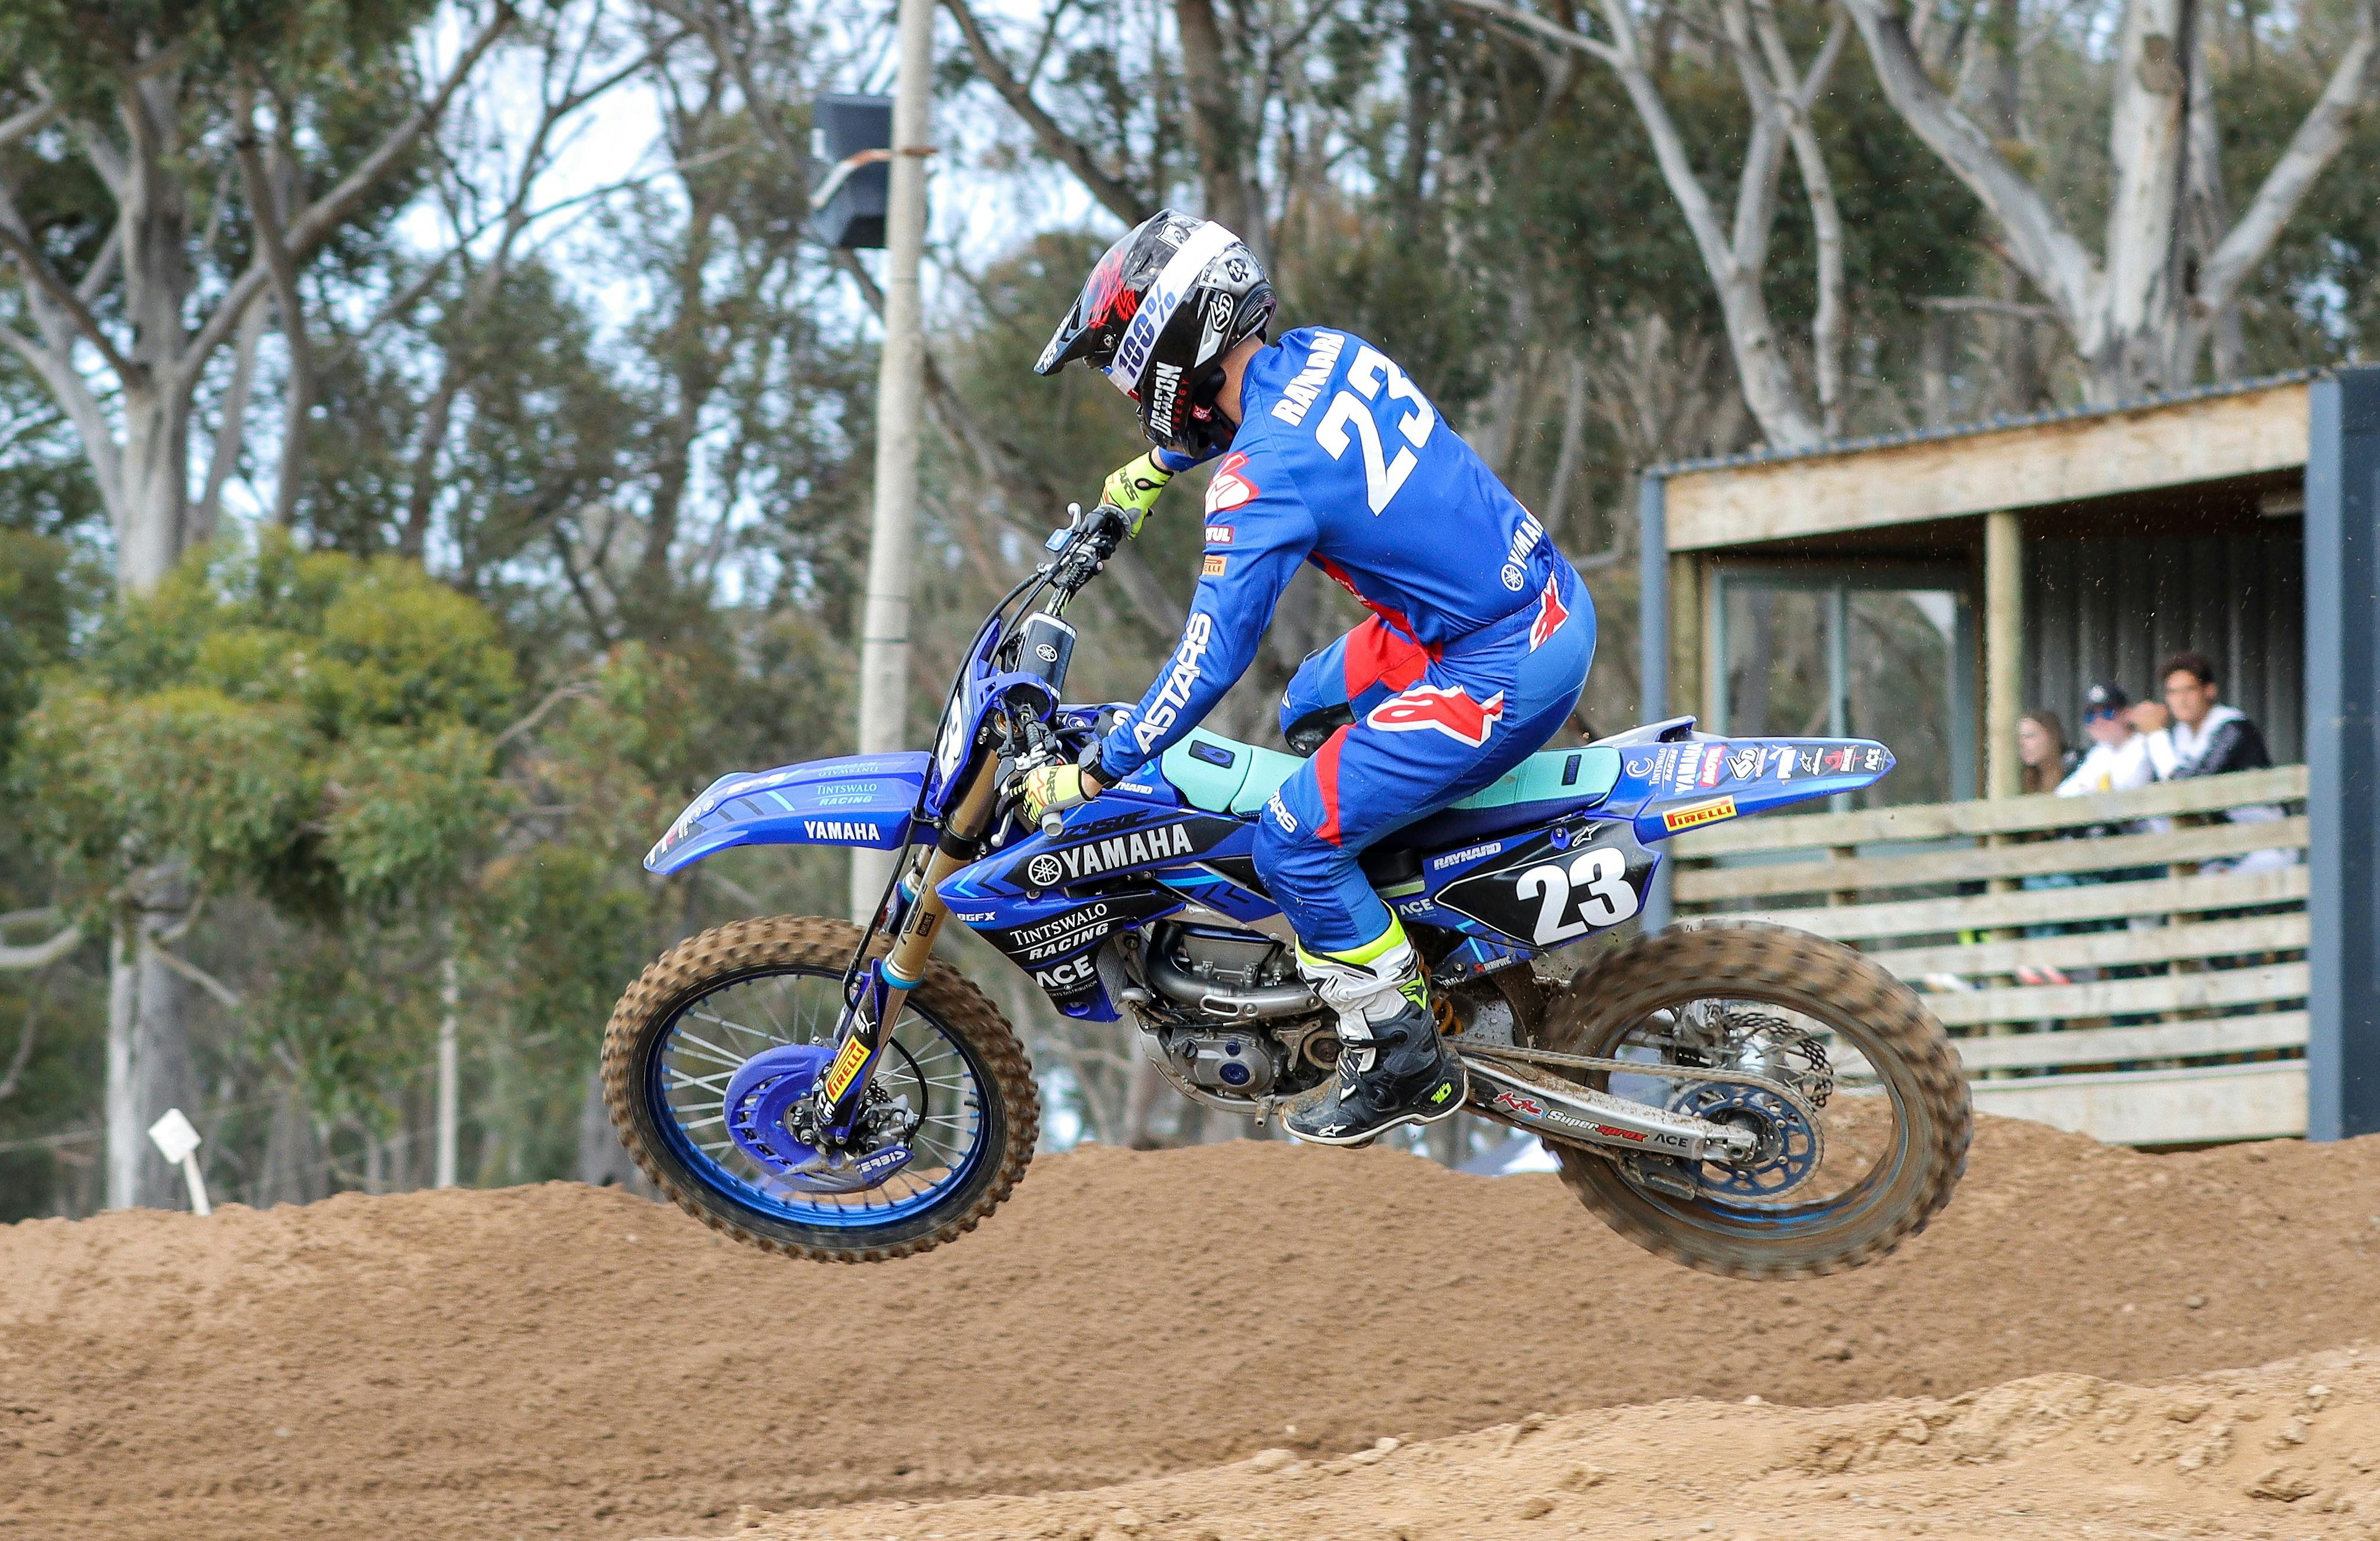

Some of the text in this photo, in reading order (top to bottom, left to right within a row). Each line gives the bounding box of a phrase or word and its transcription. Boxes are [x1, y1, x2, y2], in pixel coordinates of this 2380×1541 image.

[1119, 283, 1175, 378] 100%
[1315, 345, 1436, 517] 23
[1133, 612, 1212, 755] ASTARS
[1674, 742, 1705, 793] YAMAHA
[816, 784, 878, 795] TINTSWALO
[819, 796, 873, 806] RACING
[804, 820, 880, 840] YAMAHA
[1667, 799, 1732, 828] PIRELLI
[1060, 824, 1193, 879] YAMAHA
[1434, 842, 1502, 870] RAYNARD
[1399, 898, 1435, 915] ACE
[1516, 847, 1639, 946] 23
[1010, 903, 1108, 946] TINTSWALO
[1029, 922, 1109, 960] RACING
[1036, 955, 1095, 987] ACE
[828, 1042, 865, 1097] PIRELLI
[1654, 1133, 1688, 1148] ACE
